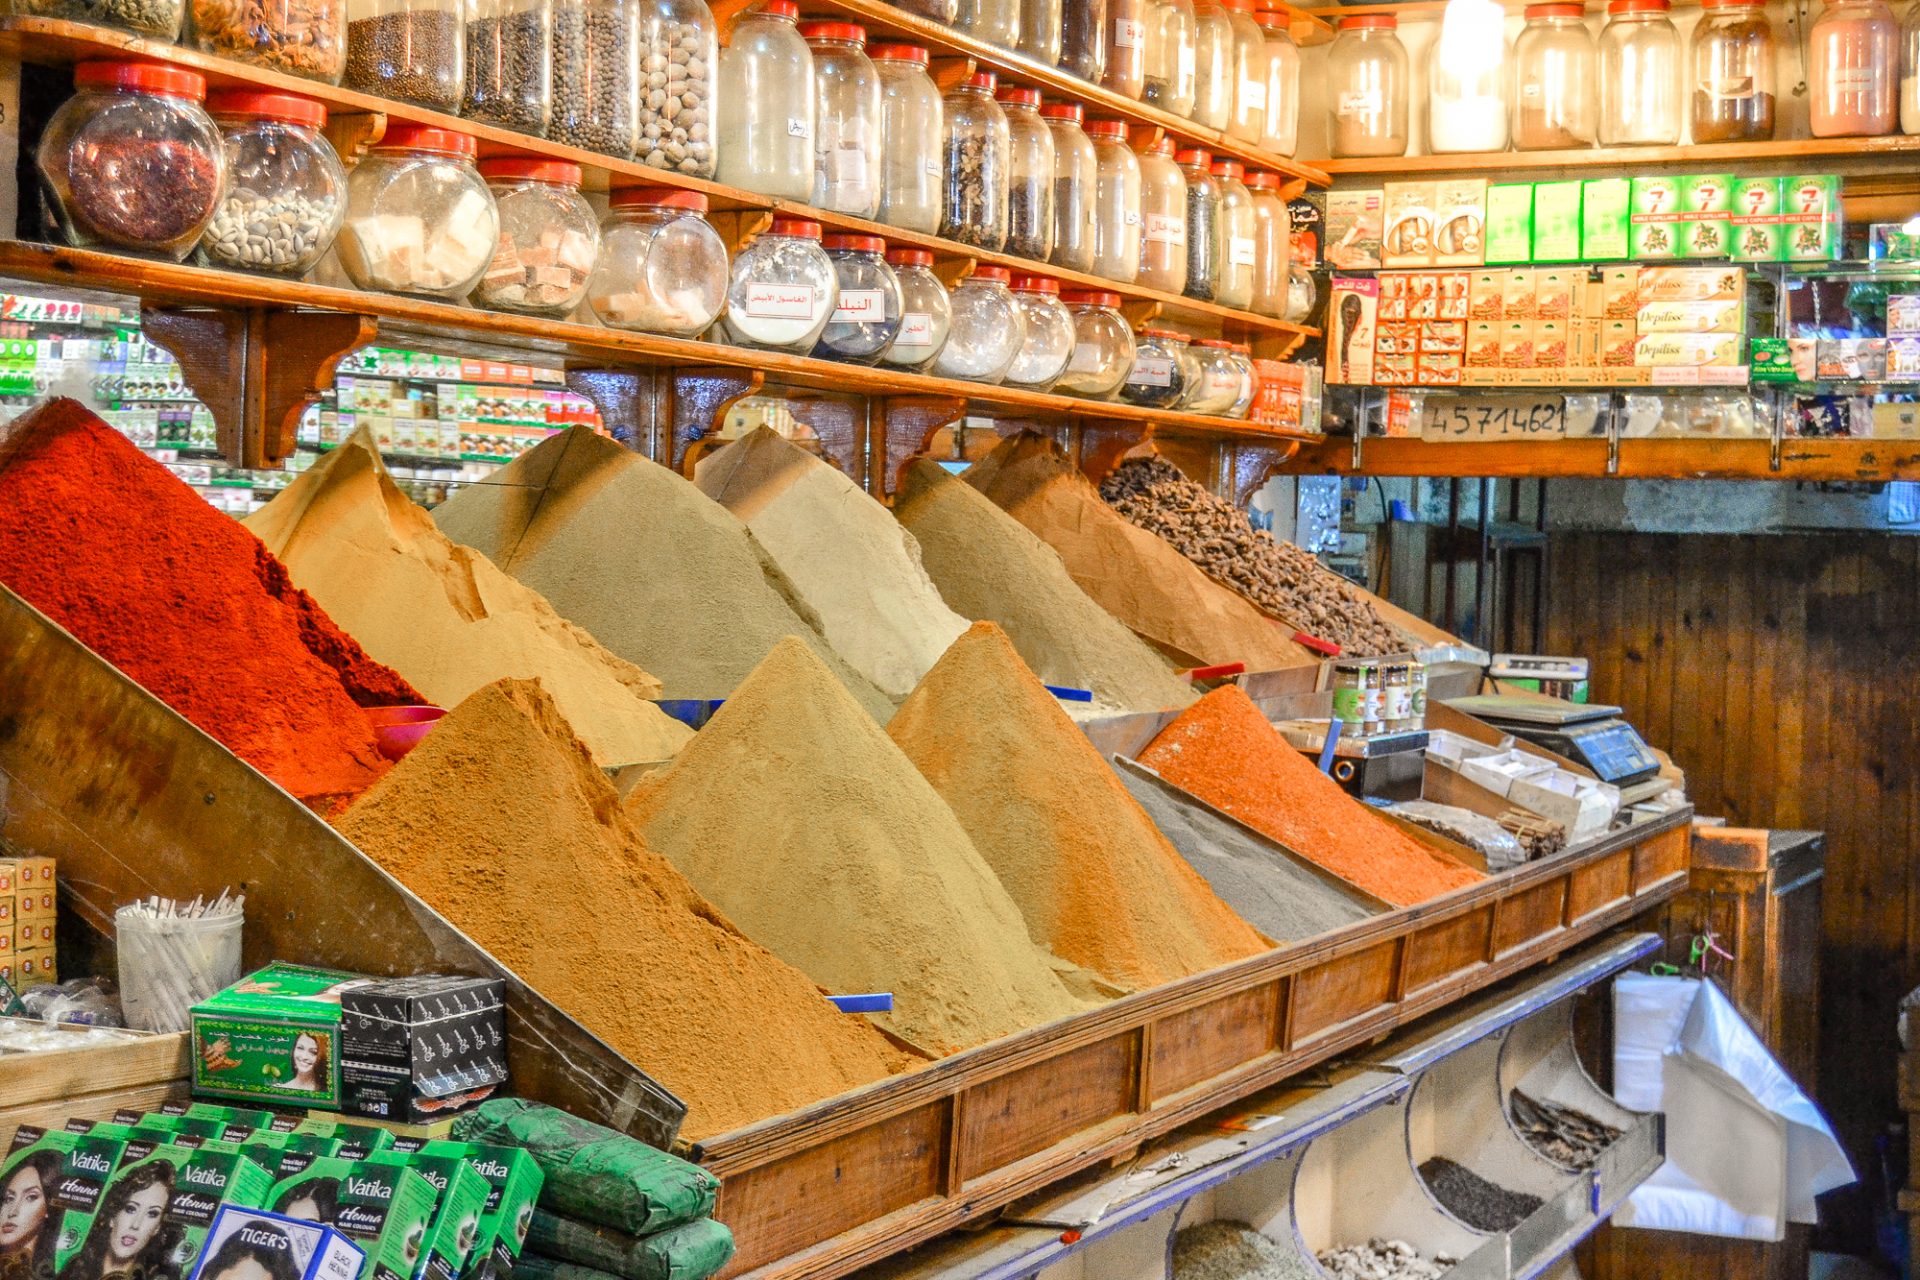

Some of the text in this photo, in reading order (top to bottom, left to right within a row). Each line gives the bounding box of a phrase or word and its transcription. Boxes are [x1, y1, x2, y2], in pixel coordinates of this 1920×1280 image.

[1639, 343, 1682, 358] Depiliss
[71, 1150, 110, 1173] Vatika
[185, 1164, 226, 1187] Vatika
[60, 1178, 98, 1196] Henna
[347, 1176, 392, 1199] Vatika
[174, 1193, 215, 1211] Henna
[339, 1206, 382, 1223] Henna
[338, 1221, 377, 1231] HAIR COLOURS
[240, 1227, 289, 1250] TIGER'S
[333, 1249, 352, 1267] BLACK
